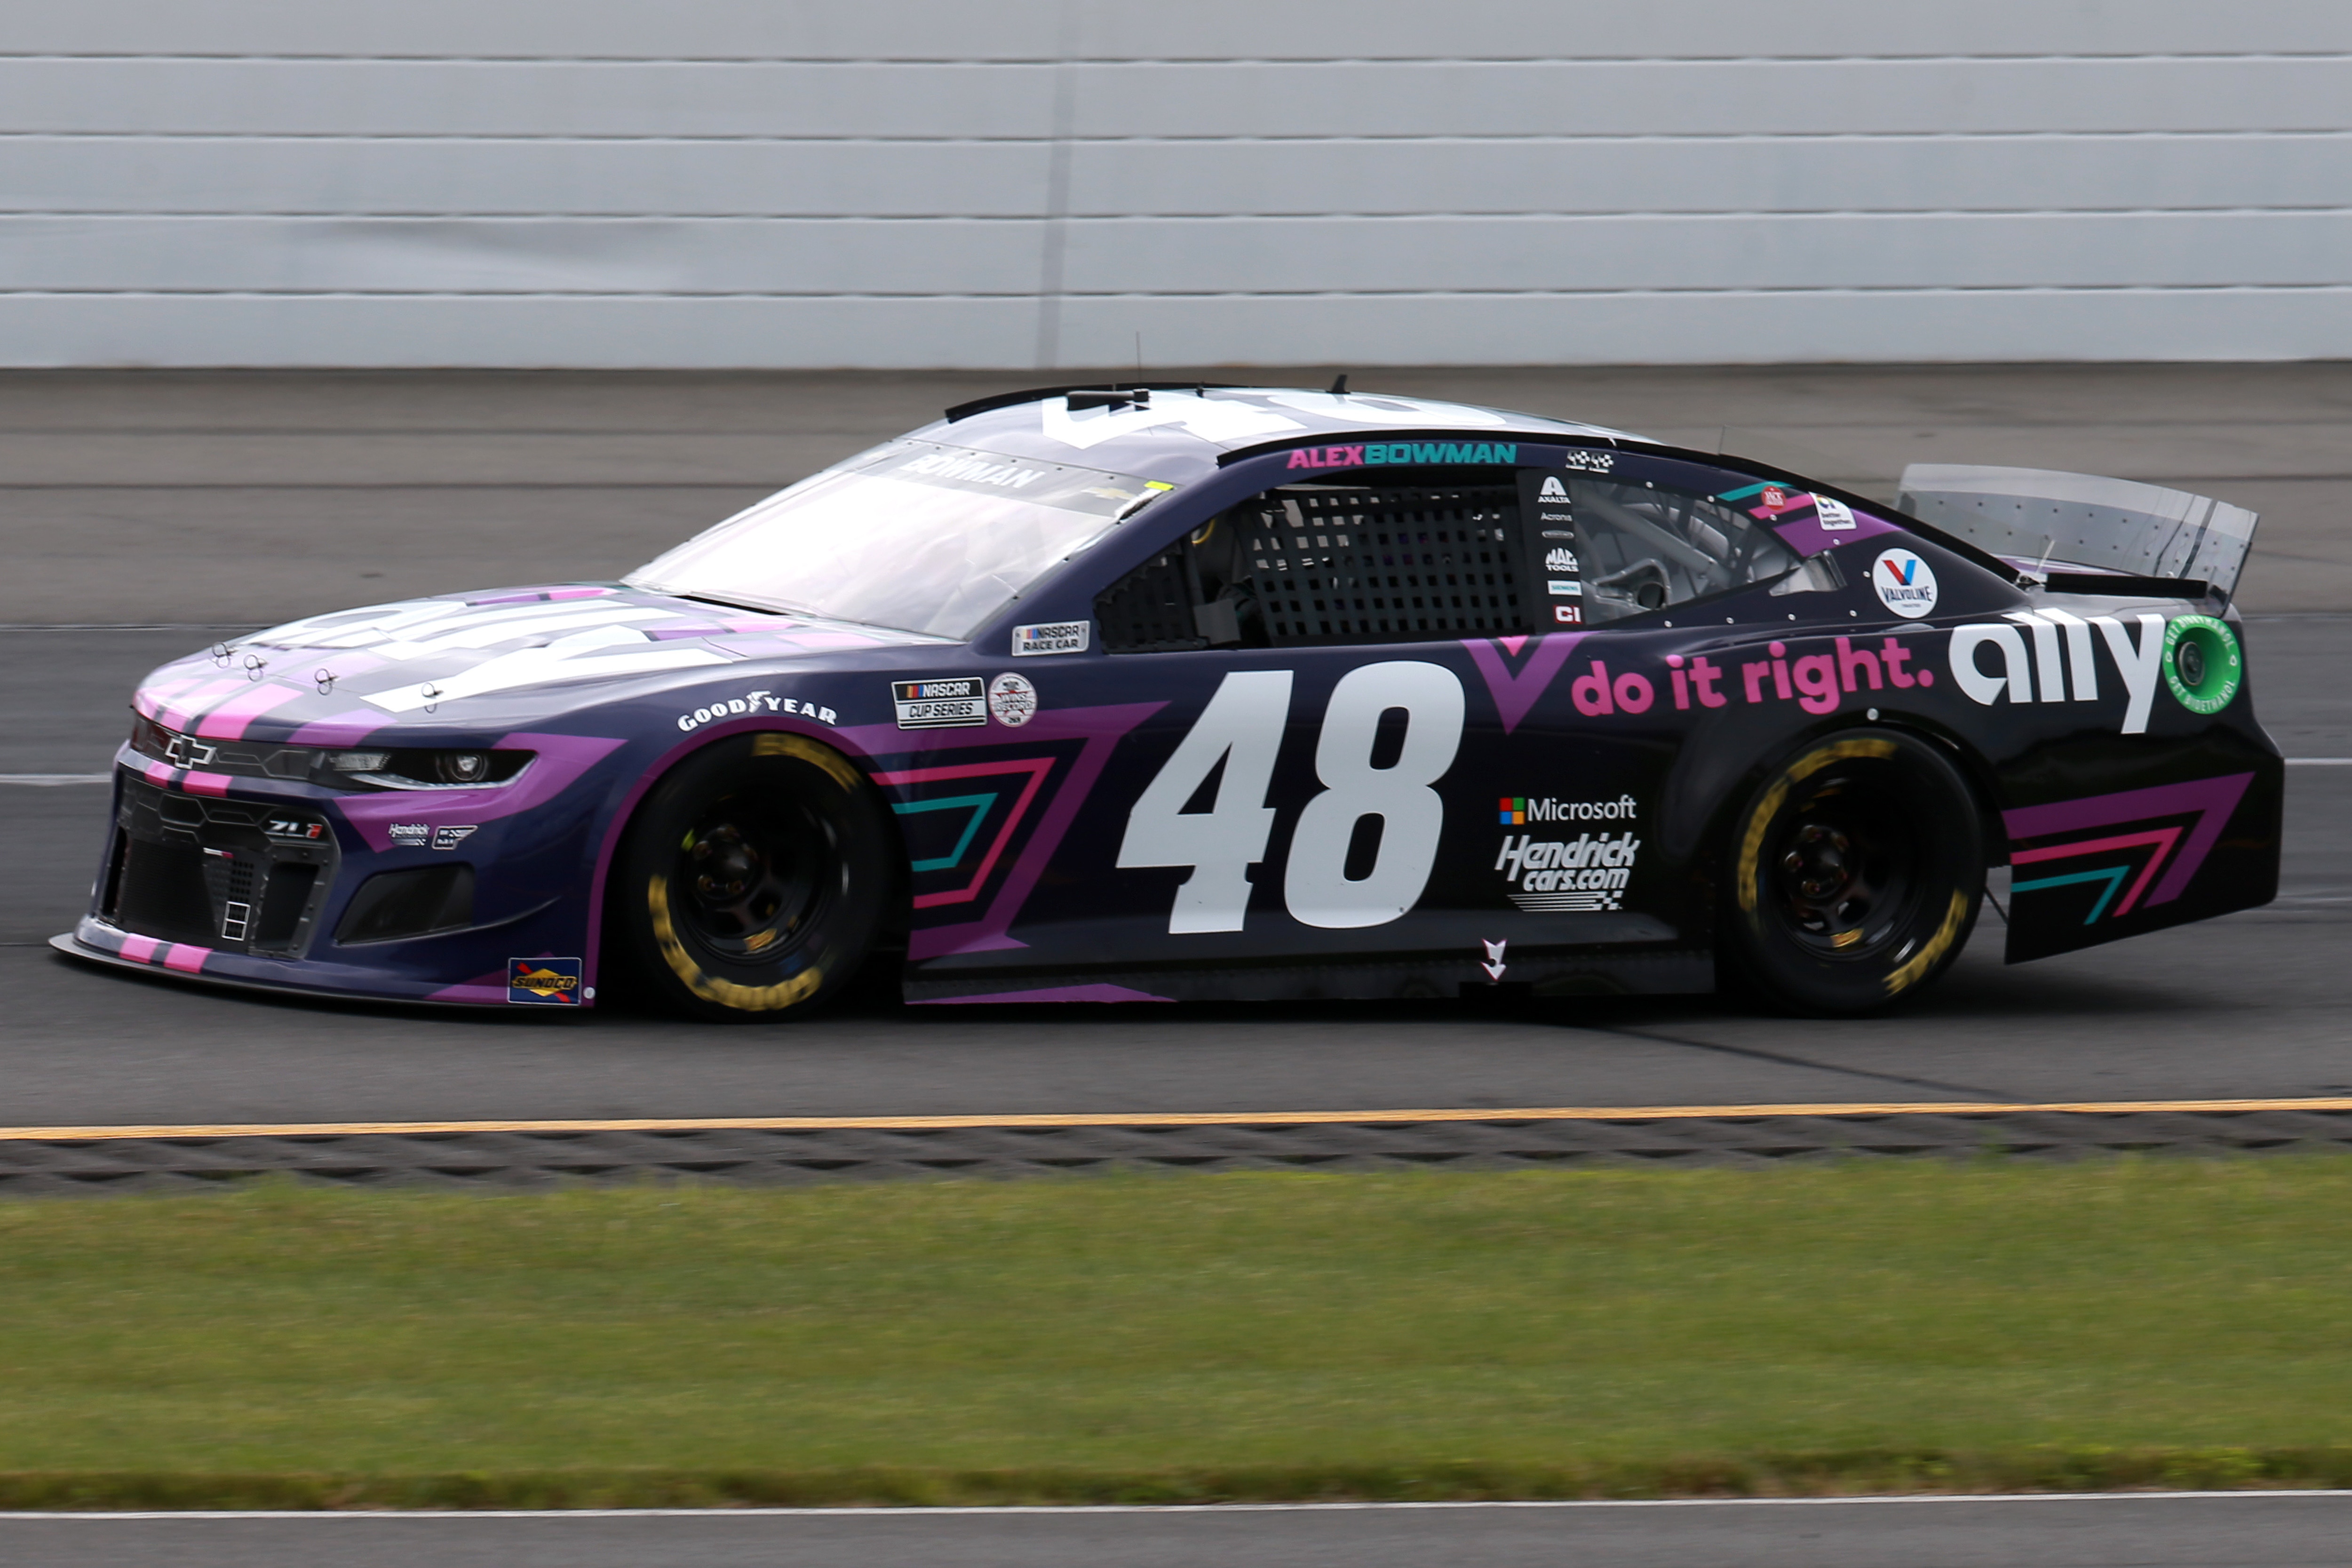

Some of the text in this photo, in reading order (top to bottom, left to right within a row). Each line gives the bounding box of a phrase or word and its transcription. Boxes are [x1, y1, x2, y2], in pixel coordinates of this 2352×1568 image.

[1545, 547, 1579, 566] MAC
[1881, 586, 1933, 603] VALVOLINE
[1038, 625, 1080, 637] NASCAR
[1023, 638, 1079, 651] RACE CAR
[1571, 637, 1934, 716] do it right.
[1948, 607, 2165, 734] ally
[922, 682, 970, 698] NASCAR
[2169, 676, 2235, 712] GET BIOETHANOL
[677, 694, 837, 732] GOODYEAR
[909, 702, 973, 717] CUP SERIES
[1115, 660, 1466, 934] 48
[1528, 794, 1637, 821] Microsoft
[1494, 832, 1641, 881] Hendrick
[1523, 868, 1630, 891] cars.com
[517, 977, 574, 988] SUNOCO
